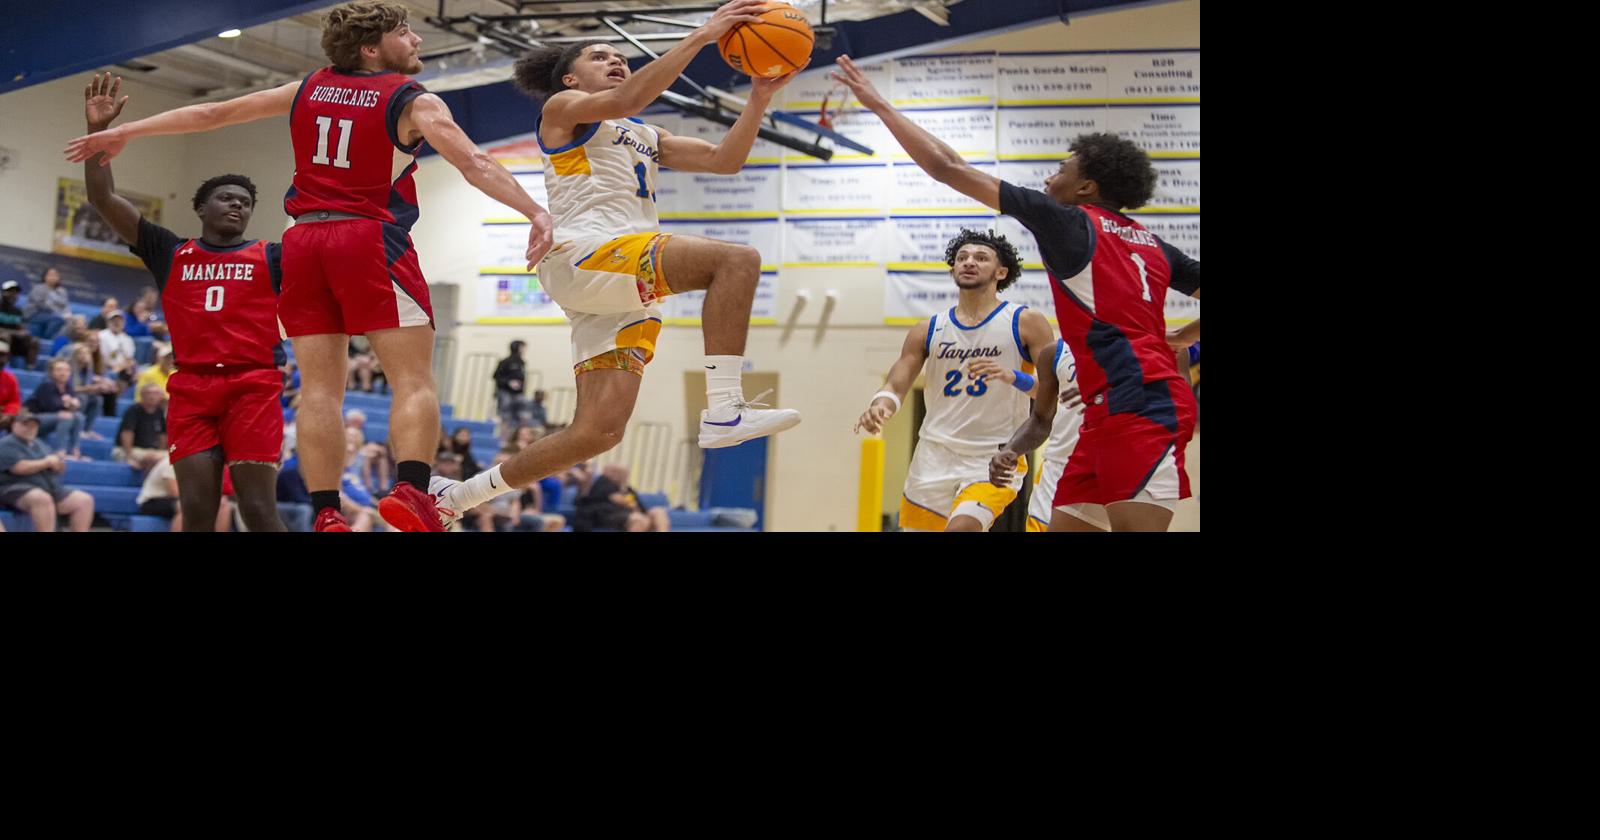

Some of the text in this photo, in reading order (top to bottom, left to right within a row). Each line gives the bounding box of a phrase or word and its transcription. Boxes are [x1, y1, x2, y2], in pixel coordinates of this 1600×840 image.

[1134, 70, 1193, 79] Consulting
[310, 85, 380, 108] HURRICANES
[312, 115, 354, 169] 11
[181, 263, 254, 281] MANATEE
[1130, 252, 1152, 302] 1
[204, 285, 225, 312] 0
[936, 342, 1002, 364] Tarpons
[943, 369, 988, 397] 23
